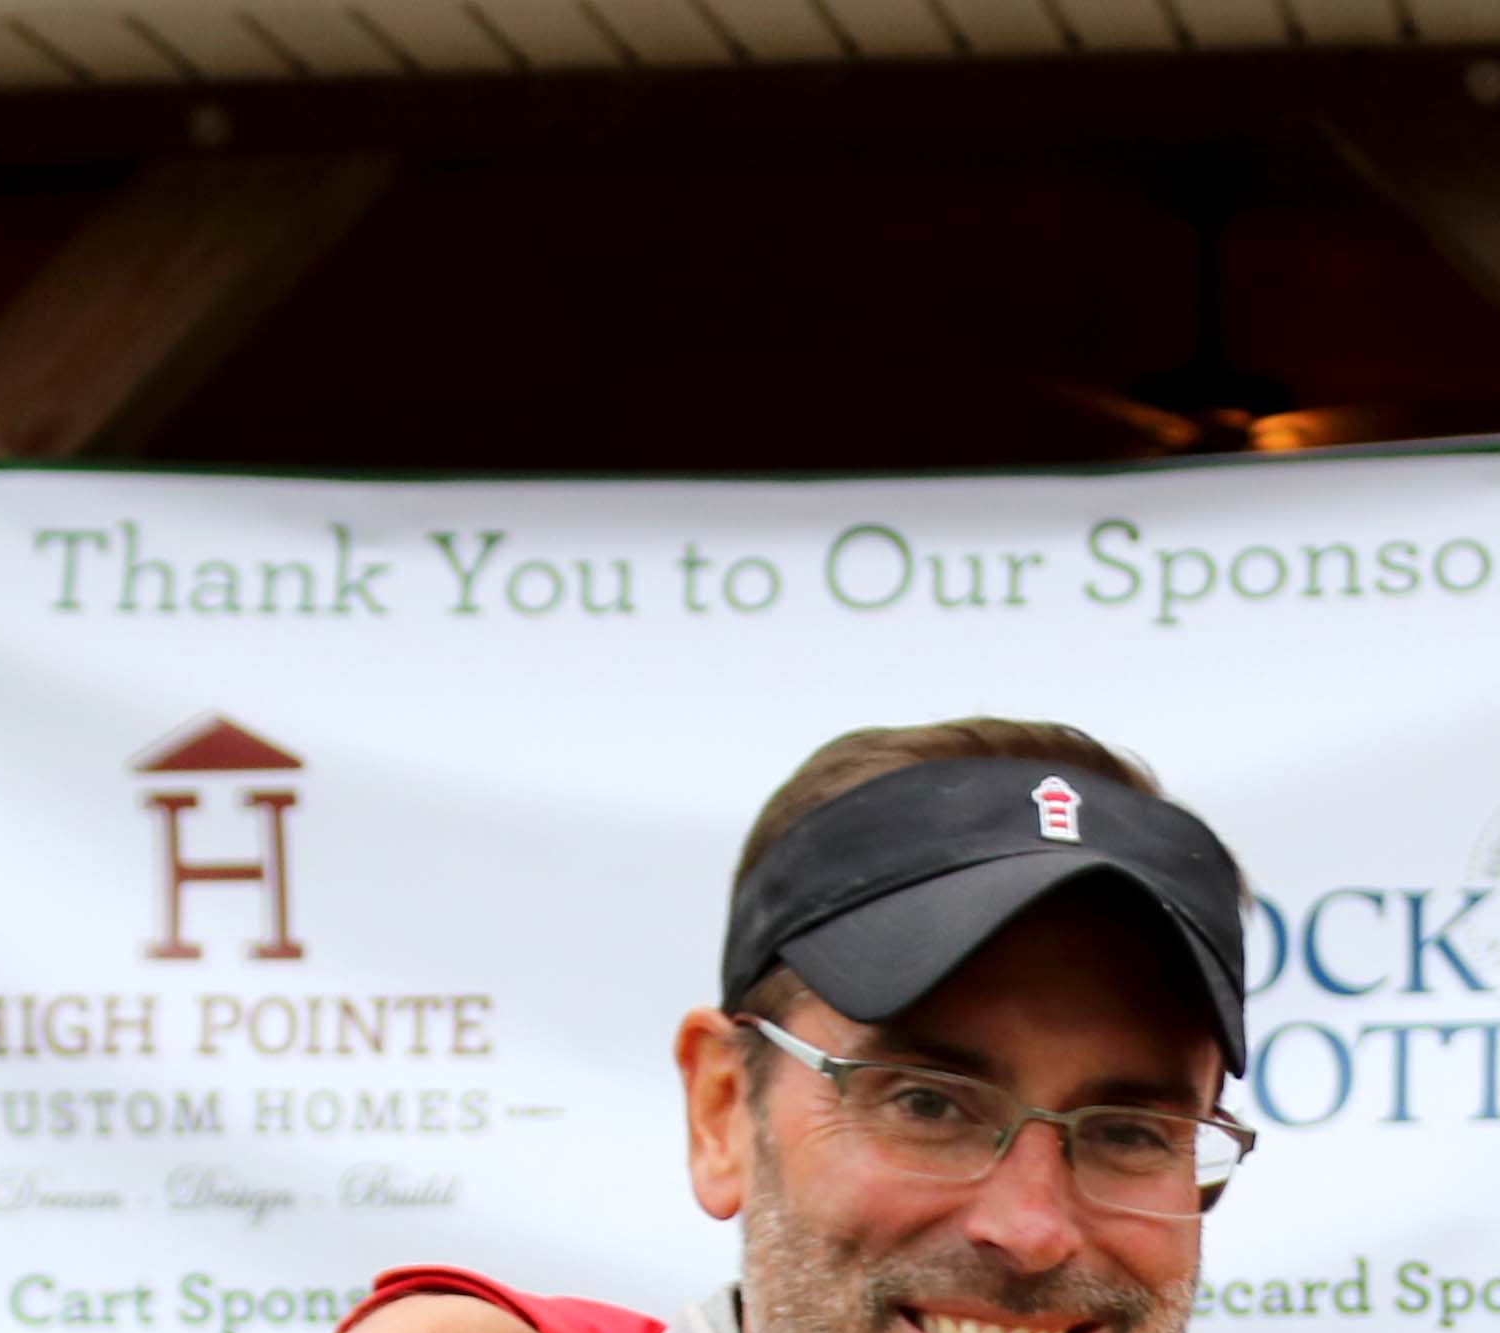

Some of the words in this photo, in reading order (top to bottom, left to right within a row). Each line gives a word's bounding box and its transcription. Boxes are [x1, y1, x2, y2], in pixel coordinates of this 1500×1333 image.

[31, 519, 391, 616] Thank
[424, 528, 636, 616] You
[674, 540, 784, 614] to
[823, 520, 1045, 613] Our
[197, 993, 495, 1059] POINTE
[250, 1087, 492, 1140] HOMES
[163, 1163, 297, 1228] Design
[7, 1272, 156, 1330] Cart
